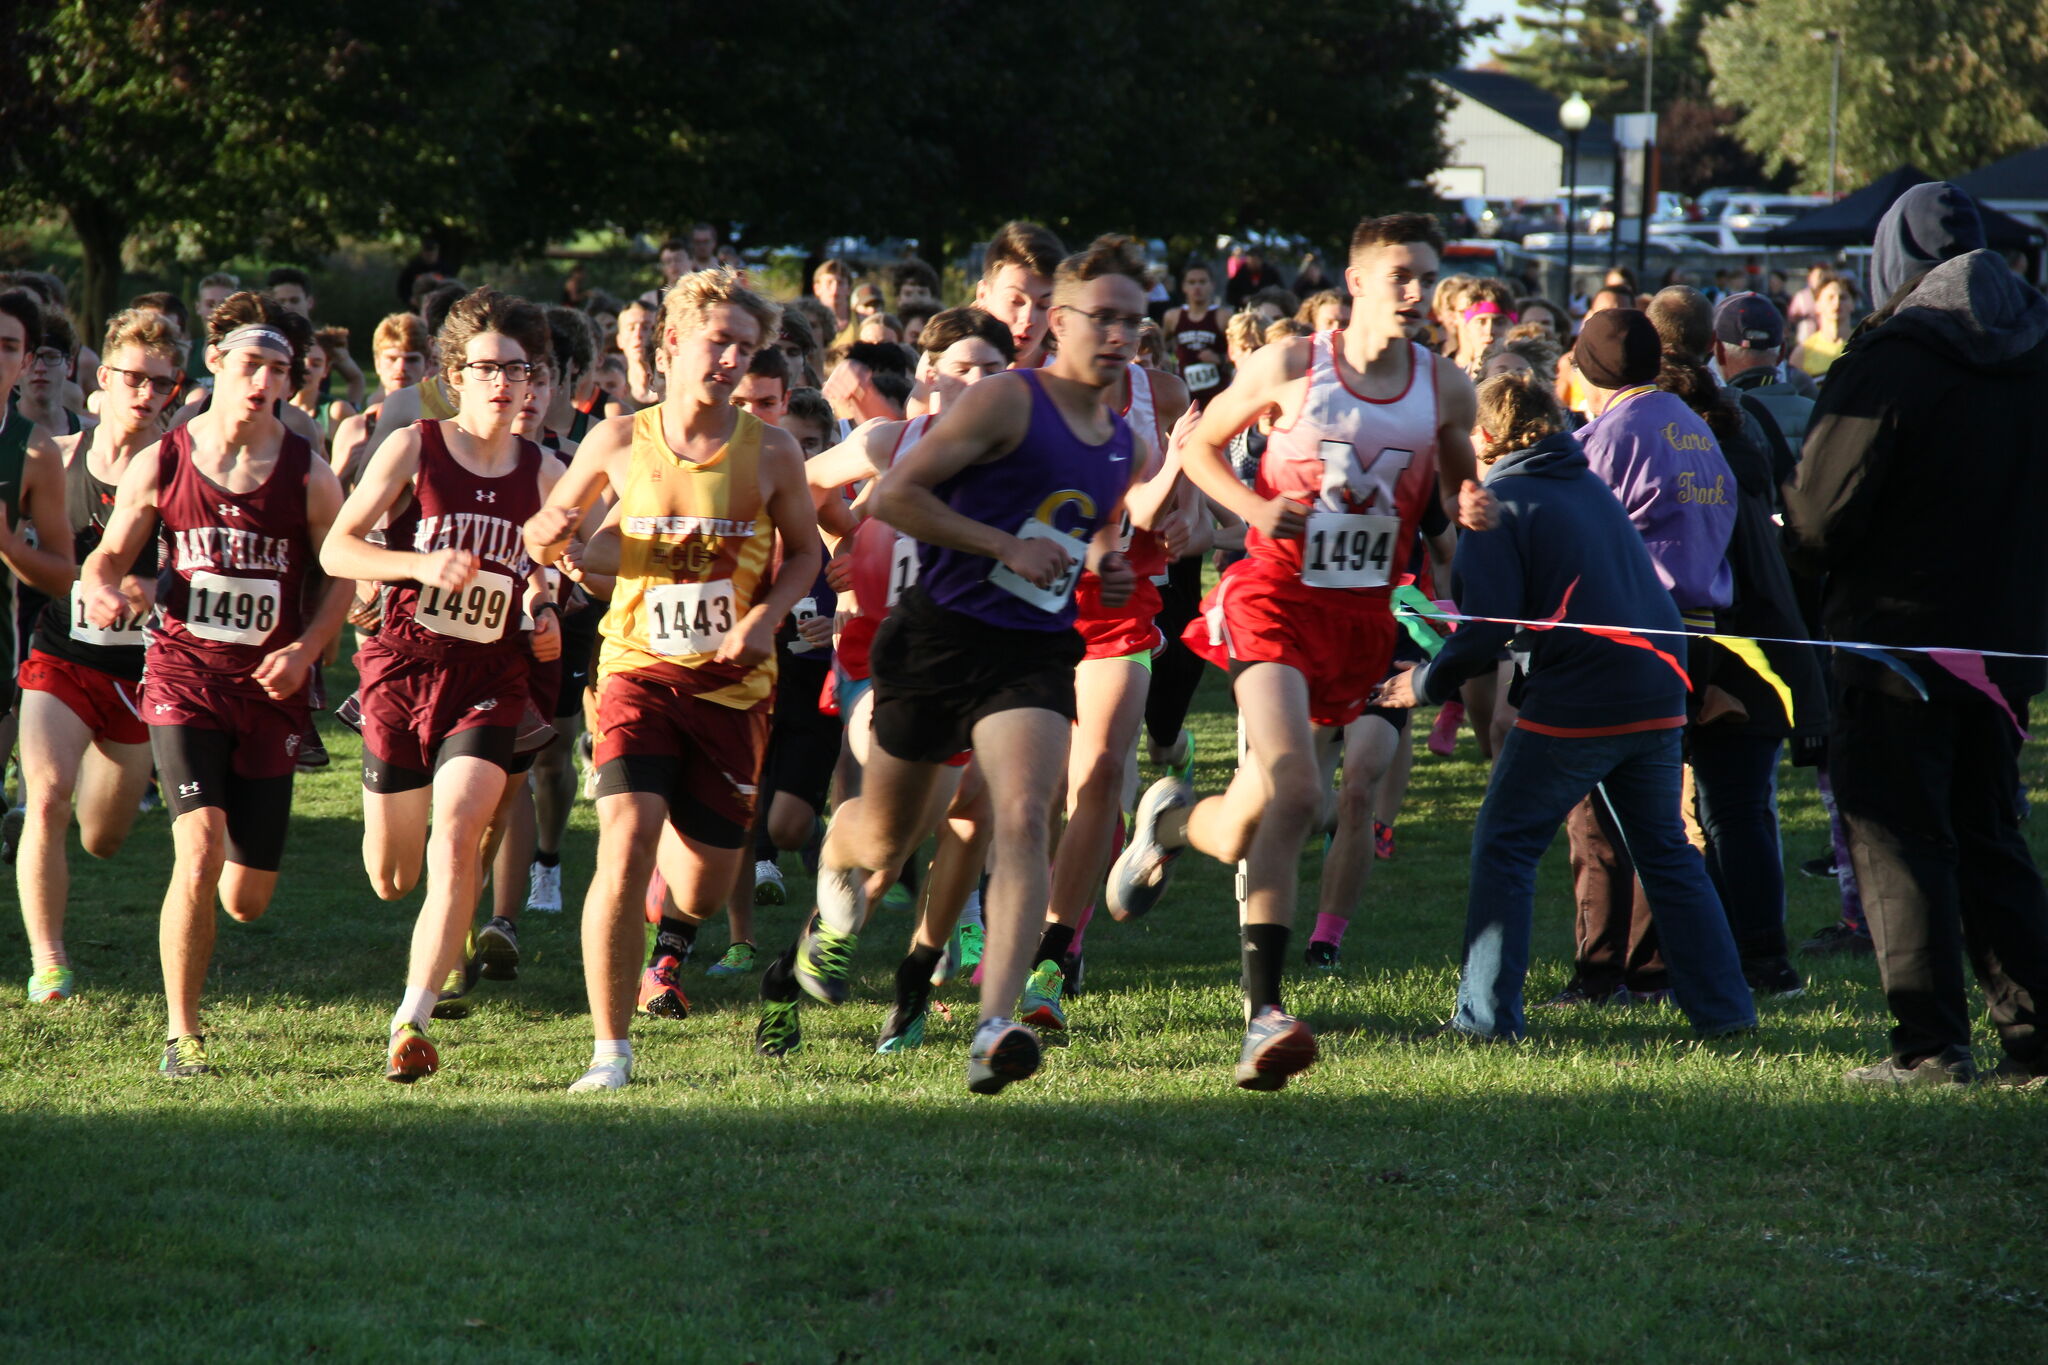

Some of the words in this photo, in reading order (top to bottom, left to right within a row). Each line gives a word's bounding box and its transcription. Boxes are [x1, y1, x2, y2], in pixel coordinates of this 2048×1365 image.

[1659, 422, 1713, 451] Caro
[1678, 472, 1728, 504] Track
[1310, 530, 1392, 571] 1494
[194, 587, 275, 632] 1498
[423, 585, 506, 629] 1499
[654, 596, 732, 639] 1443
